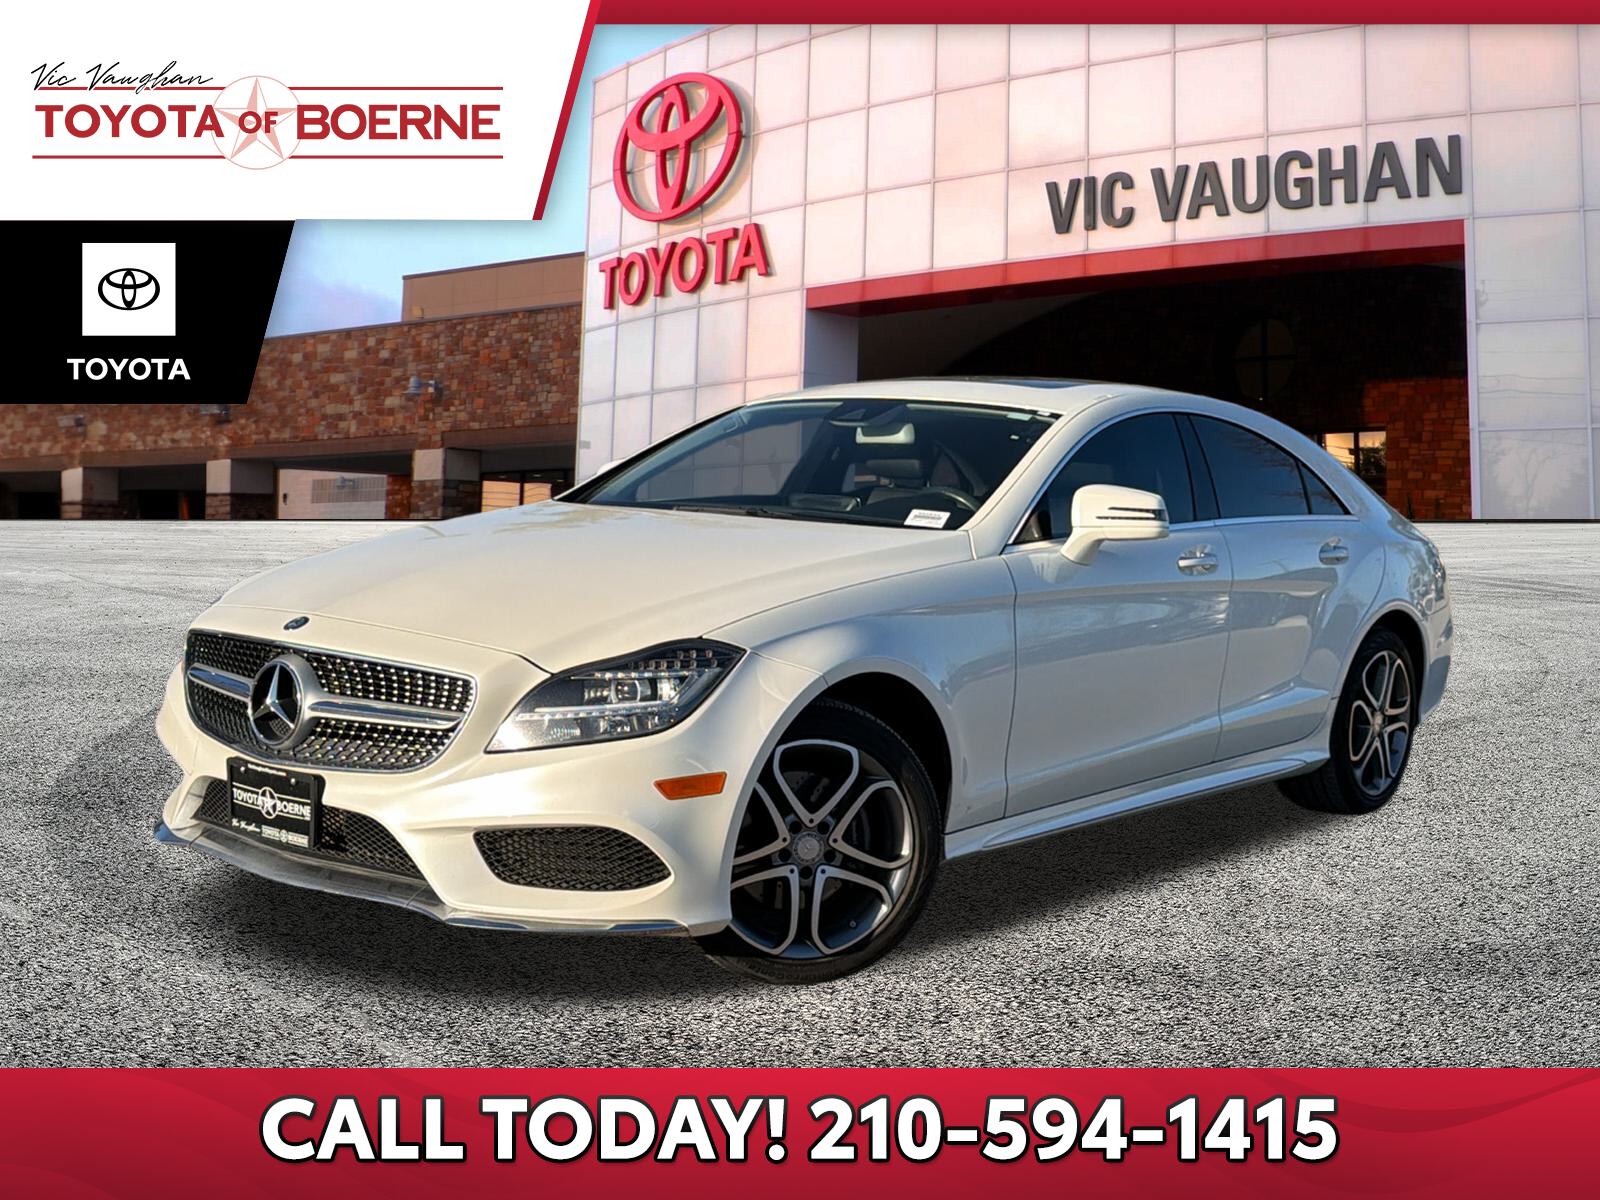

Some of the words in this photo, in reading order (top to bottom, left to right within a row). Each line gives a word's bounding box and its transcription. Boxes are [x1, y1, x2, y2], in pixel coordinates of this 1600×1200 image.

[1045, 172, 1134, 235] VIC
[1150, 134, 1463, 222] VAUGHAN
[599, 222, 769, 309] TOYOTA
[232, 787, 264, 808] TOYOTA
[276, 800, 312, 818] BOERNE
